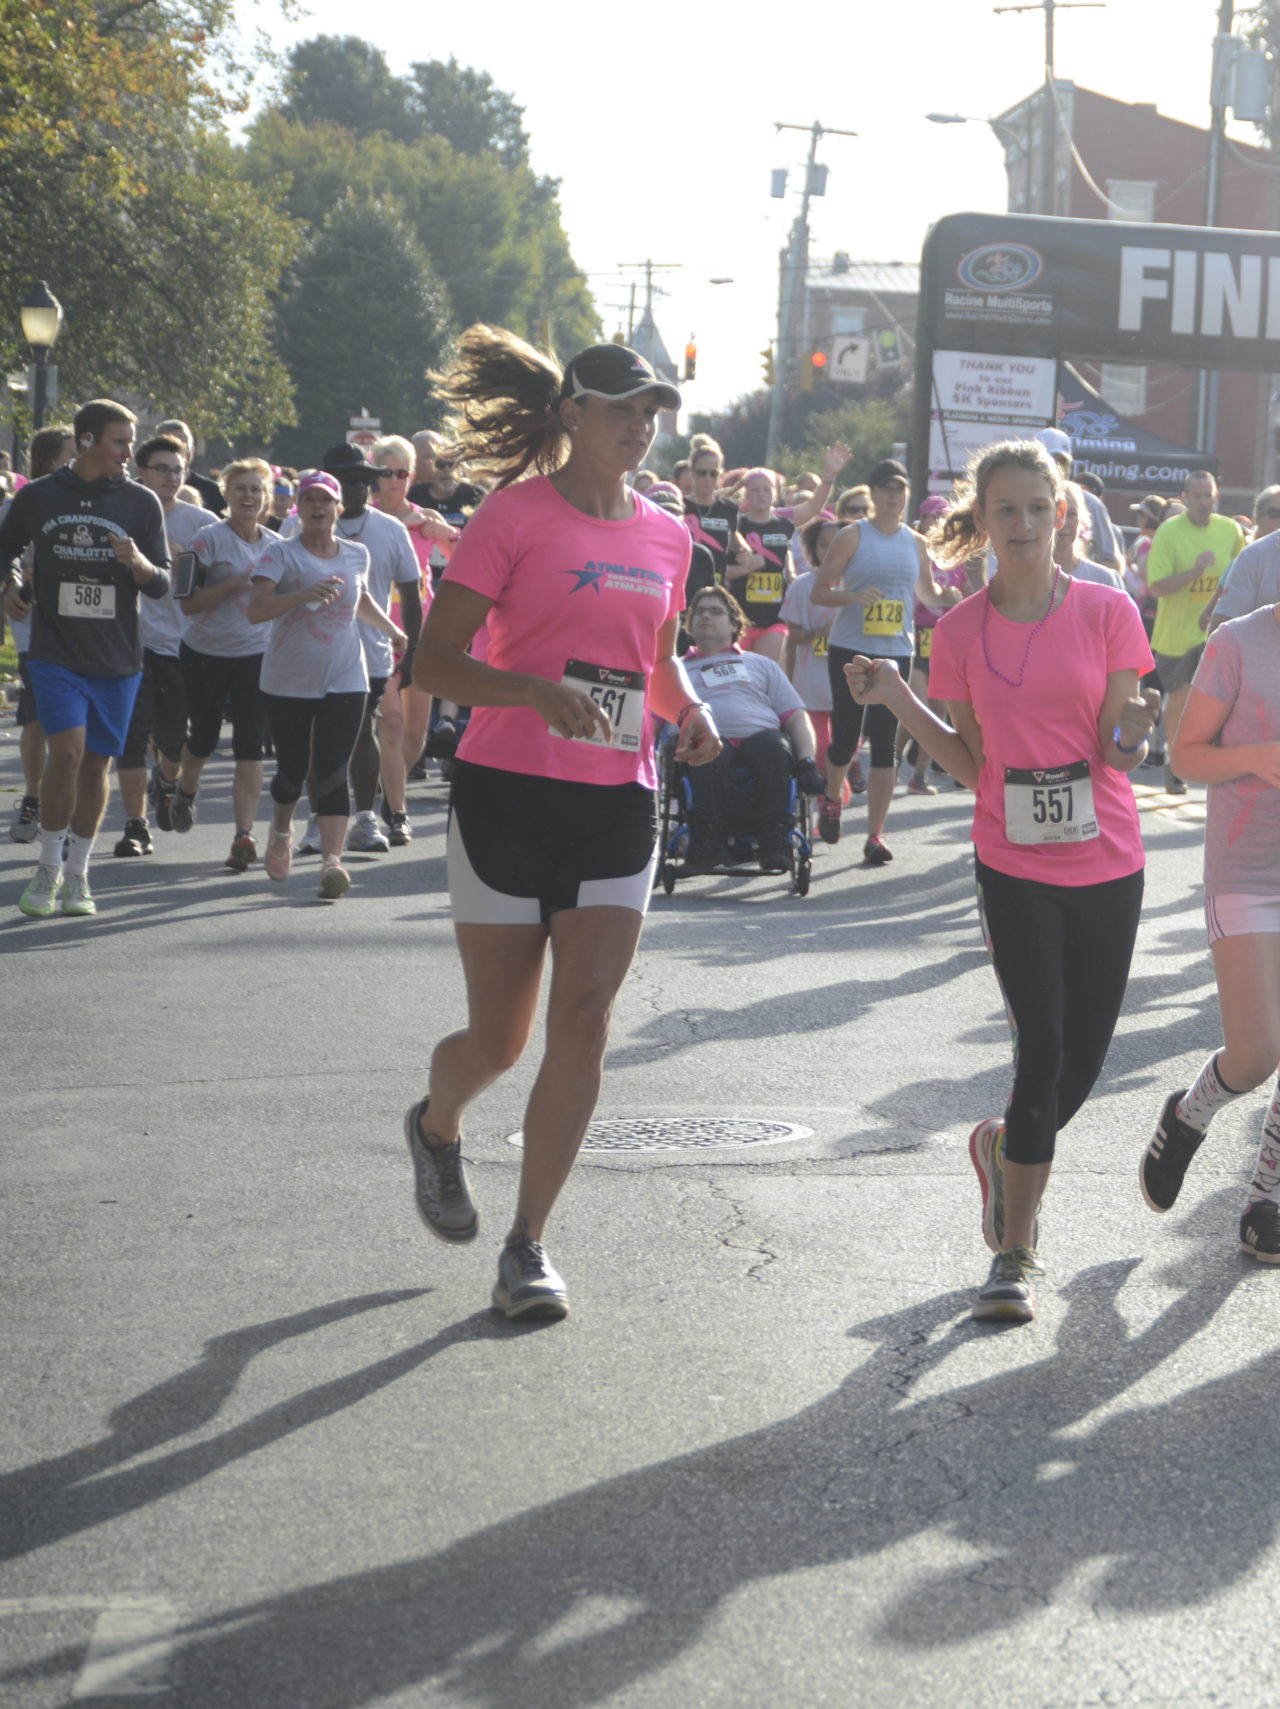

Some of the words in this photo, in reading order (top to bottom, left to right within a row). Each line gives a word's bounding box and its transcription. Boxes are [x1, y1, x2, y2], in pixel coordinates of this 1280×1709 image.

[944, 292, 984, 307] Racine
[987, 295, 1053, 312] MultiSports
[960, 359, 1004, 372] THANK
[1009, 363, 1036, 374] YOU
[979, 374, 990, 382] to
[994, 376, 1013, 384] our
[955, 382, 982, 393] Pink
[987, 385, 1031, 397] Ribbon
[952, 393, 972, 403] 5K
[976, 396, 1032, 409] Sponsors
[53, 544, 116, 558] CHARLOTTE
[584, 560, 665, 585] ATHLETES
[74, 585, 102, 606] 588
[864, 602, 904, 623] 2128
[713, 663, 736, 678] 568
[1032, 785, 1073, 824] 557
